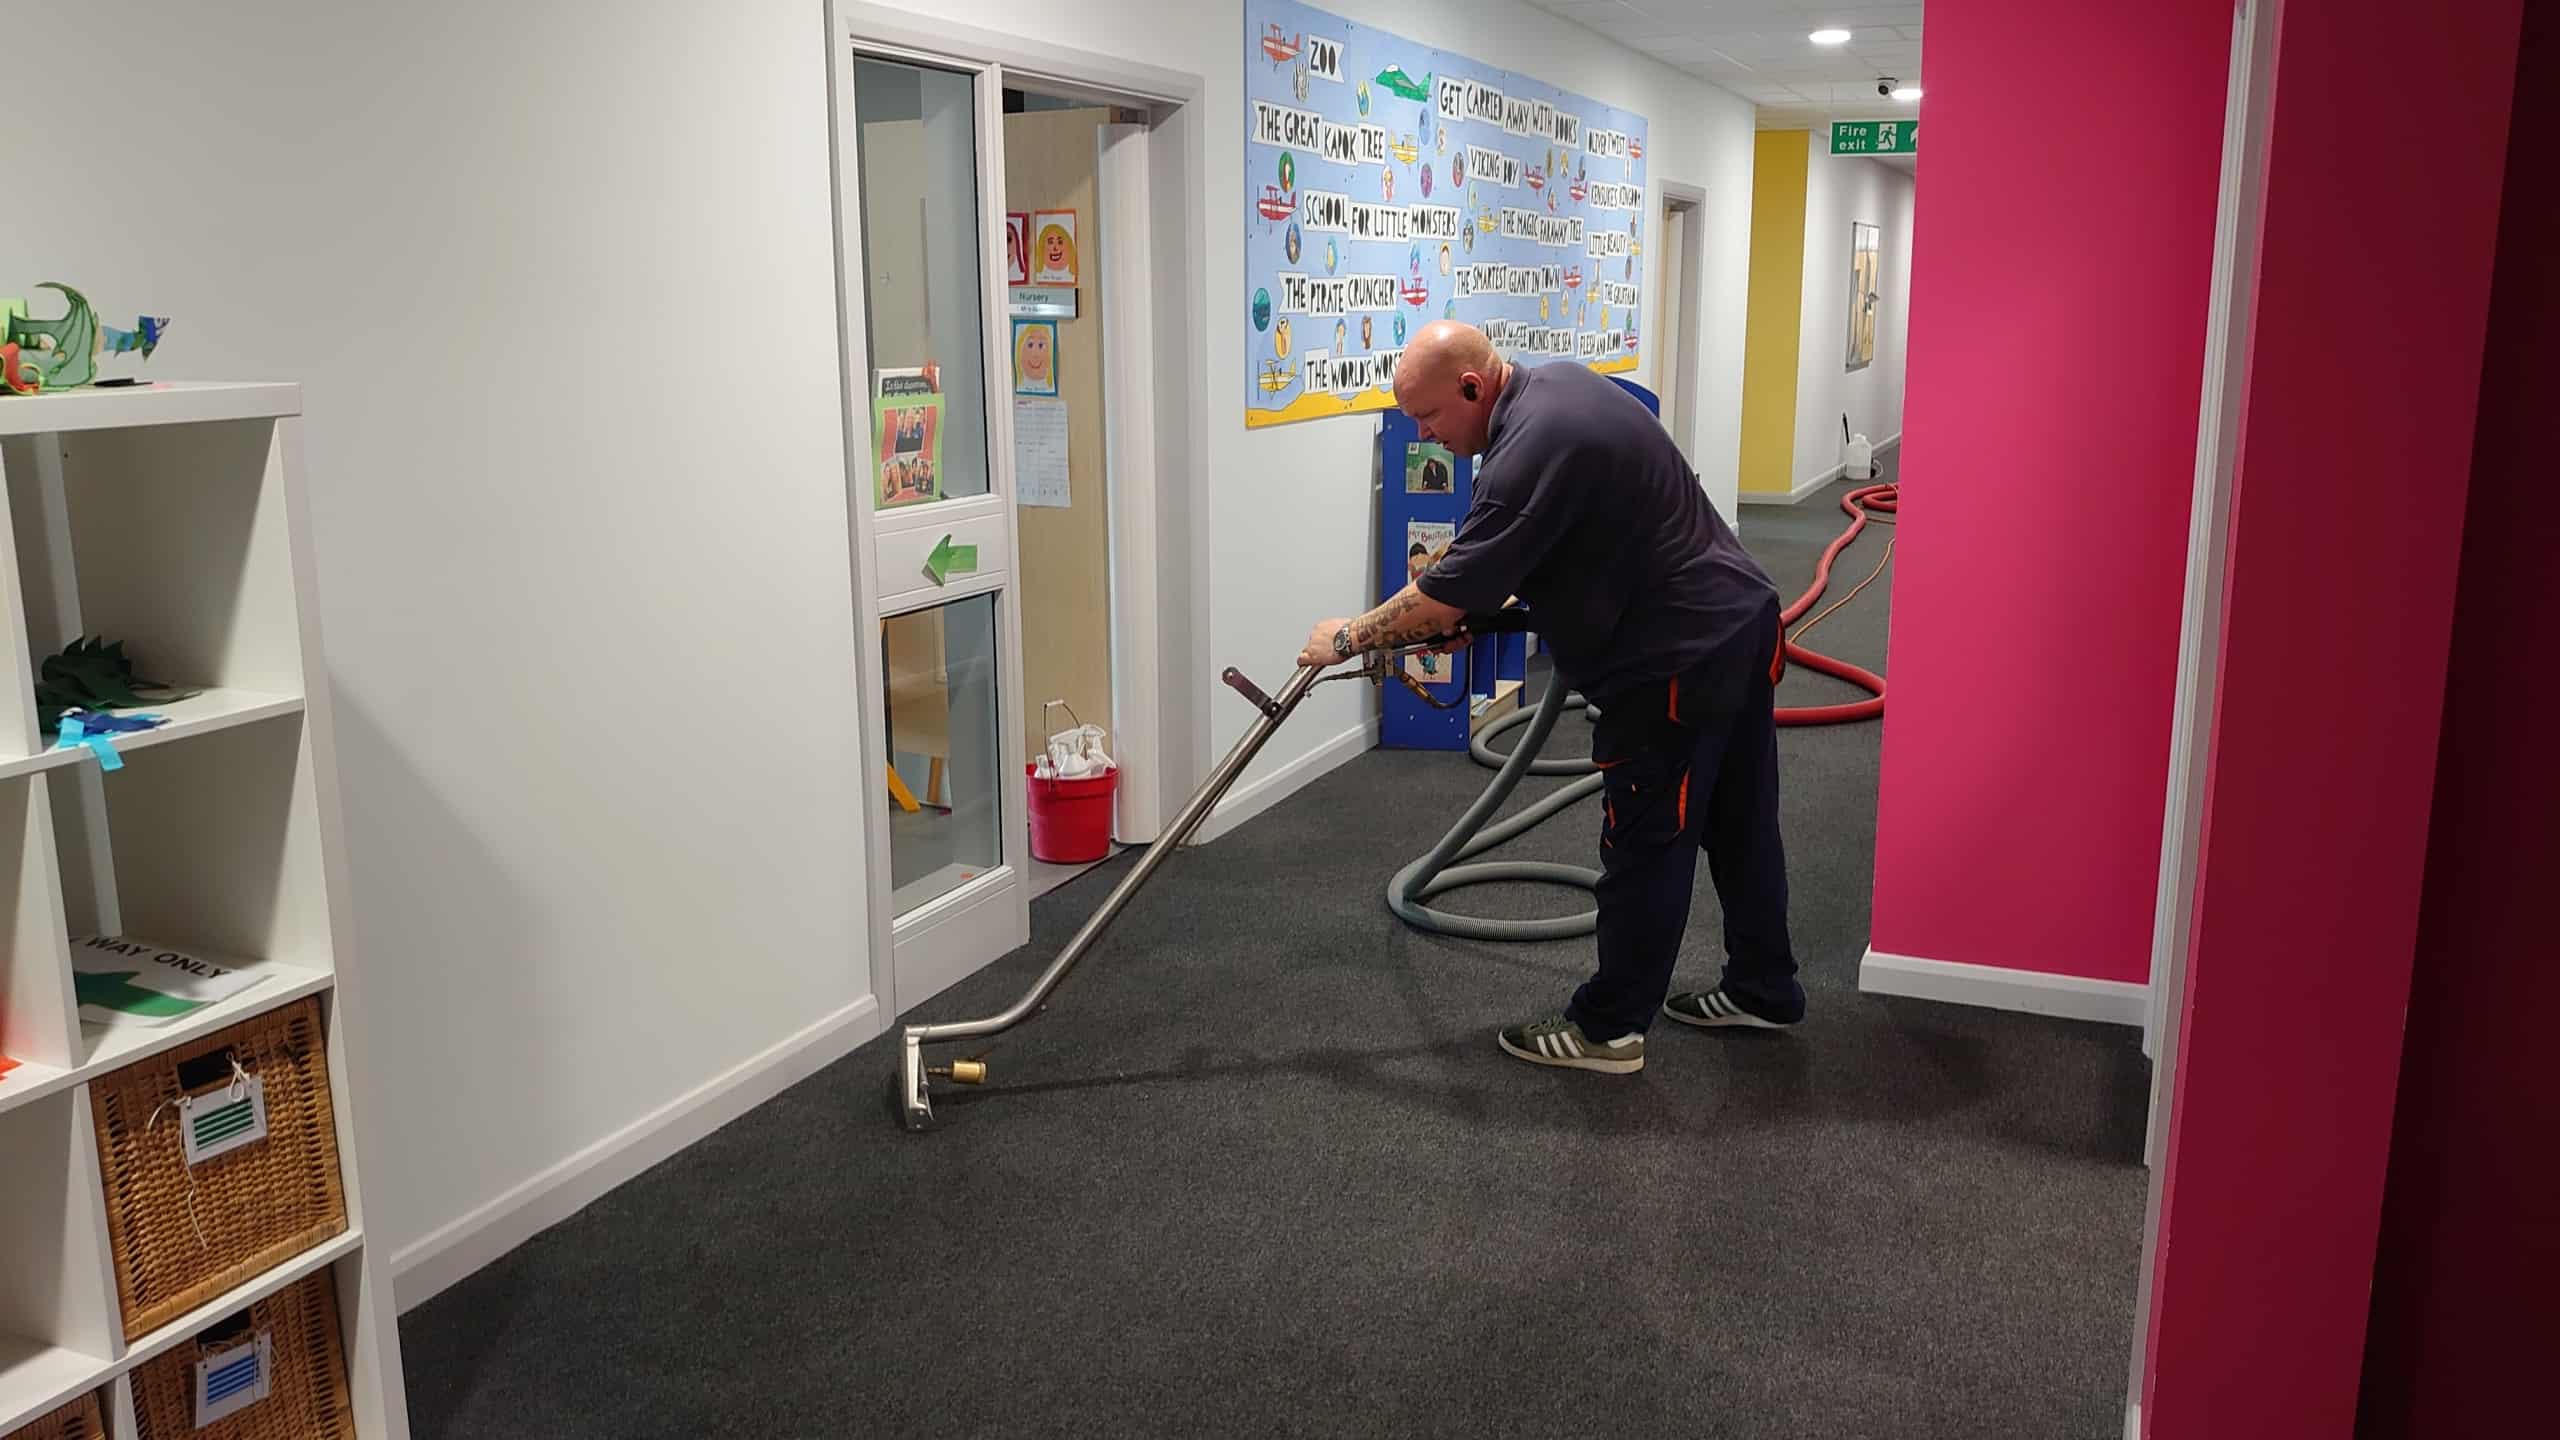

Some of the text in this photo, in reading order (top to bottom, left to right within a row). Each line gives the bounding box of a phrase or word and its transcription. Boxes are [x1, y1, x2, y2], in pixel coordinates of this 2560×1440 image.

[1310, 41, 1336, 75] ZOO
[1440, 82, 1577, 144] GET CARRIED AWAY WITH BOOKS
[1839, 124, 1867, 137] Fire
[1258, 105, 1384, 163] THE GREAT KAPOK TREE
[1839, 139, 1866, 151] exit
[1470, 149, 1519, 185] VIKING BOY
[1306, 195, 1457, 240] SCHOOL FOR LITTLE MONSTERS
[1502, 210, 1582, 245] THE MAGIC FARAWAY TREE
[1589, 233, 1606, 256] LITTLE
[1286, 277, 1395, 313] THE PIRATE CRUNCHER
[1456, 264, 1560, 296] THE SMARTEST GIANT IN TOWN
[1528, 329, 1549, 352] DRINKS
[1551, 333, 1560, 352] THE
[1561, 332, 1572, 352] SEA
[1307, 351, 1404, 392] THE WORLD'S WORS
[87, 937, 232, 979] WAY ONLY
